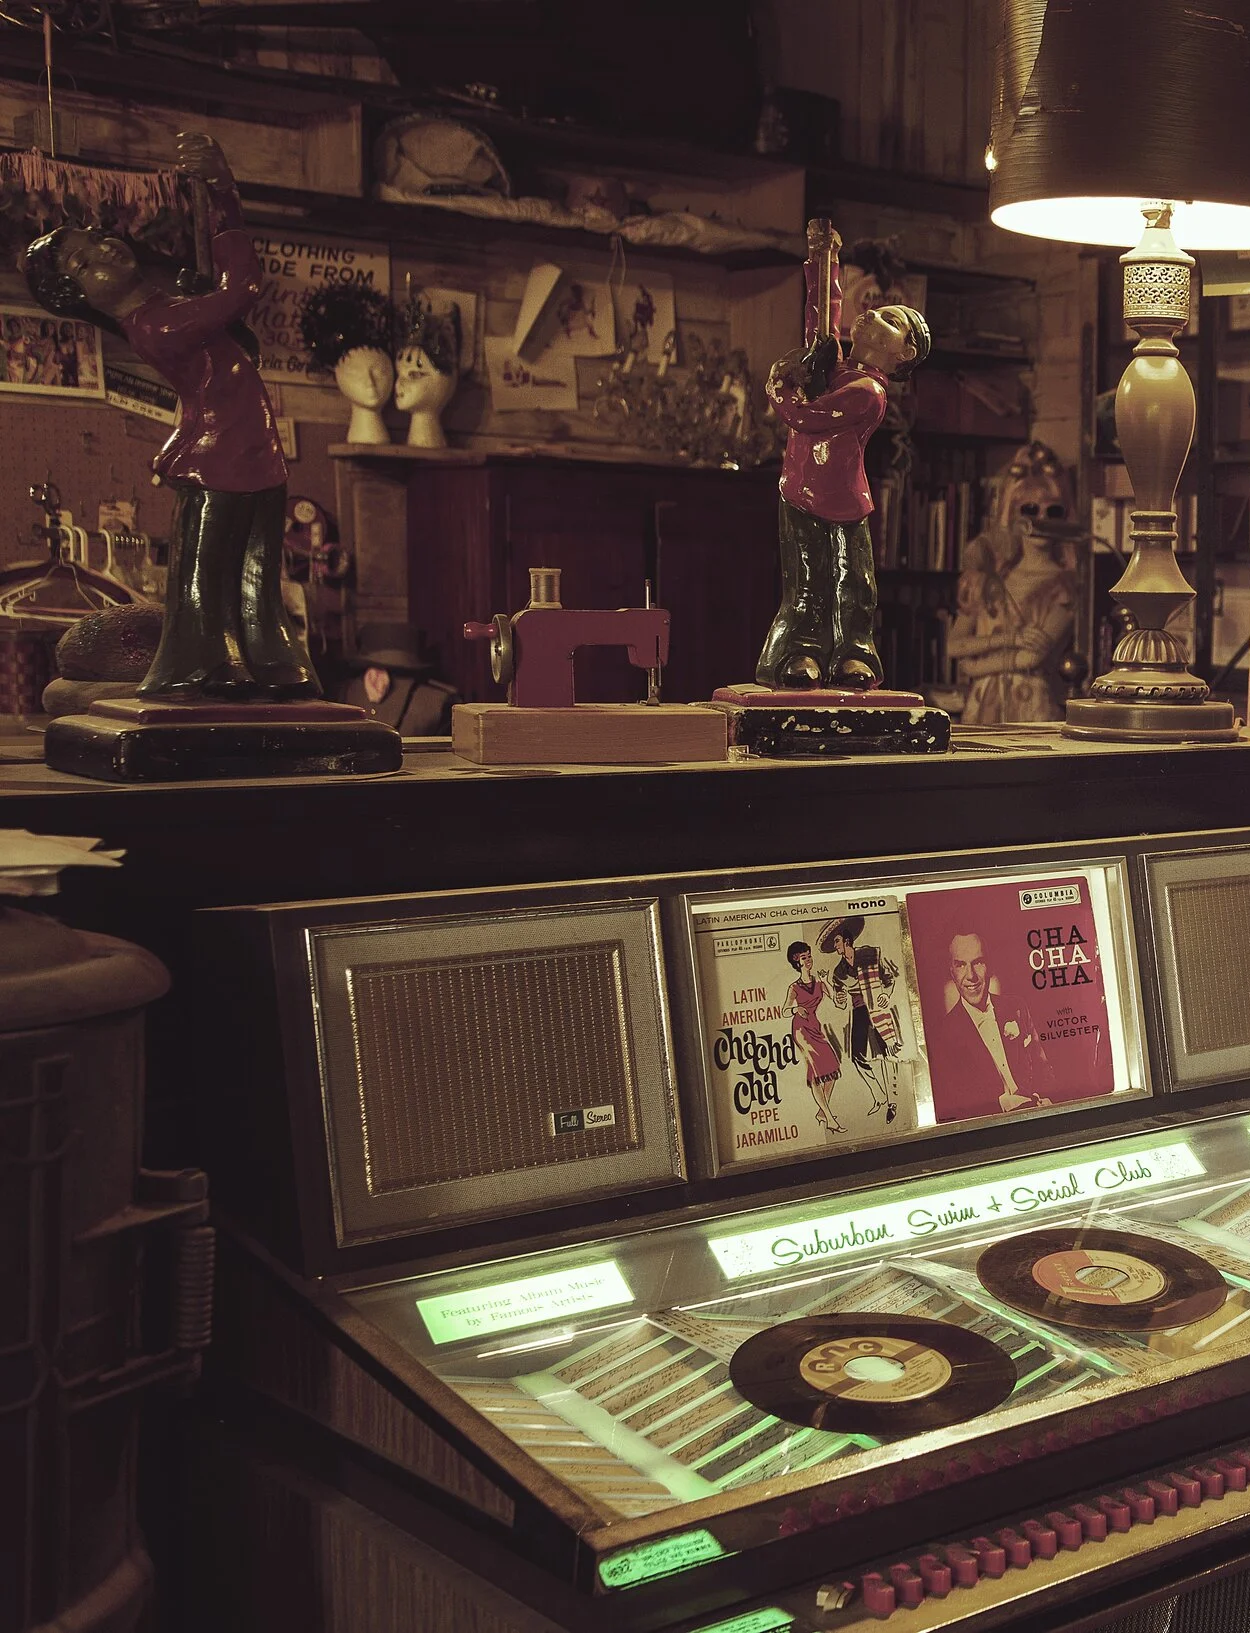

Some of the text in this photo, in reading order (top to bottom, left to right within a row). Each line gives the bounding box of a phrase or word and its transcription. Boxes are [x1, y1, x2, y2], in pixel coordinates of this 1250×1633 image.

[252, 236, 356, 265] CLOTHING
[258, 257, 374, 285] ADE FROM
[847, 899, 886, 910] mono
[1033, 890, 1074, 900] COLUMBIA
[696, 905, 829, 926] LATIN AMERICAN CHA CHA CHA
[1026, 925, 1088, 950] CHA
[1028, 944, 1092, 971] CHA
[1031, 965, 1093, 991] CHA
[733, 987, 767, 1005] LATIN
[722, 1005, 782, 1027] AMERICAN
[1046, 1015, 1088, 1029] VICTOR
[1055, 1006, 1073, 1017] with
[1040, 1024, 1100, 1042] SILVESTER
[560, 1110, 612, 1128] Full Stereo
[750, 1107, 780, 1126] PEPE
[736, 1124, 799, 1149] JARAMILLO
[771, 1221, 895, 1267] Suburban
[907, 1202, 981, 1236] Swim
[1010, 1172, 1085, 1212] Social
[1095, 1159, 1152, 1190] Club
[440, 1276, 606, 1320] Featuring Album Music
[465, 1293, 595, 1327] by Famous Artists
